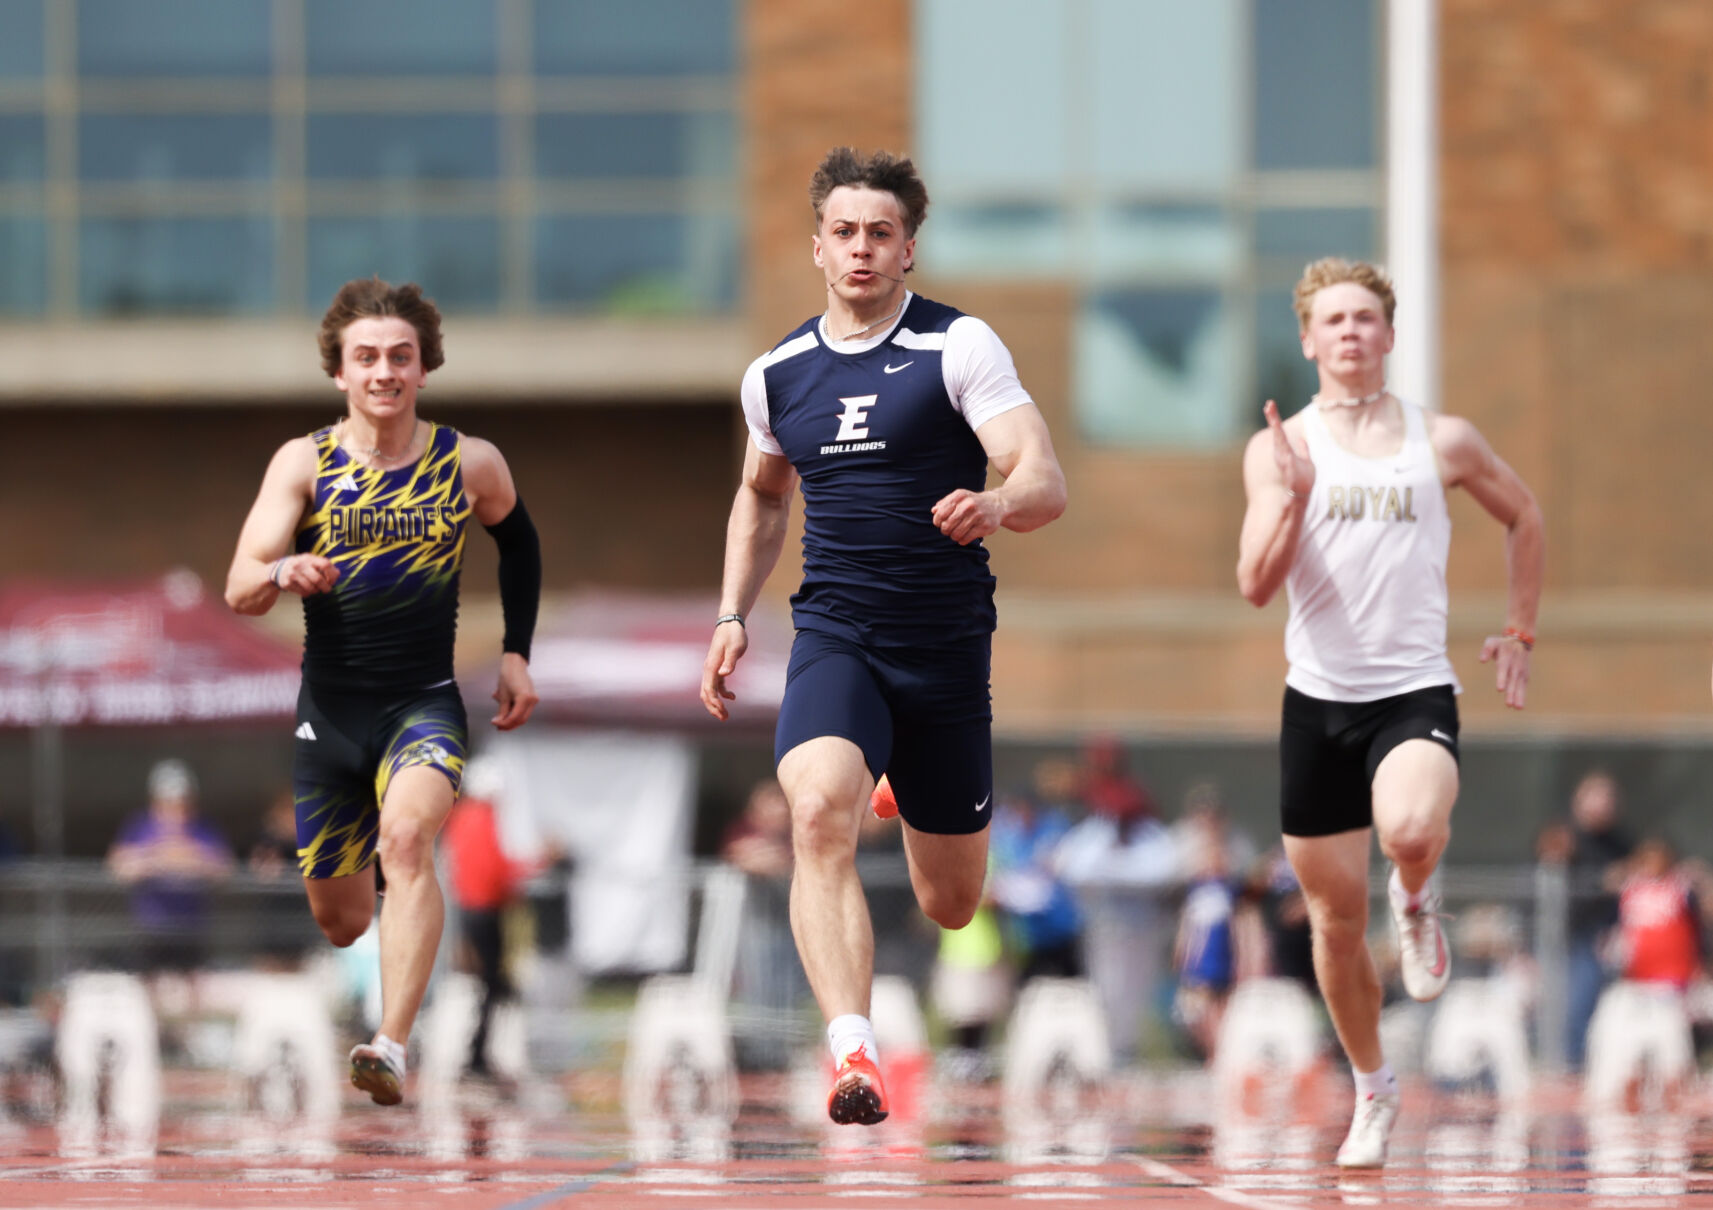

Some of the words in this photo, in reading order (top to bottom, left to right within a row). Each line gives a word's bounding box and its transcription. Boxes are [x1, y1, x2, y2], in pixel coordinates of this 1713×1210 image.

[835, 394, 878, 441] E
[820, 441, 886, 455] BULLDOGS
[1327, 486, 1417, 522] ROYAL
[328, 505, 457, 546] PIRATES
